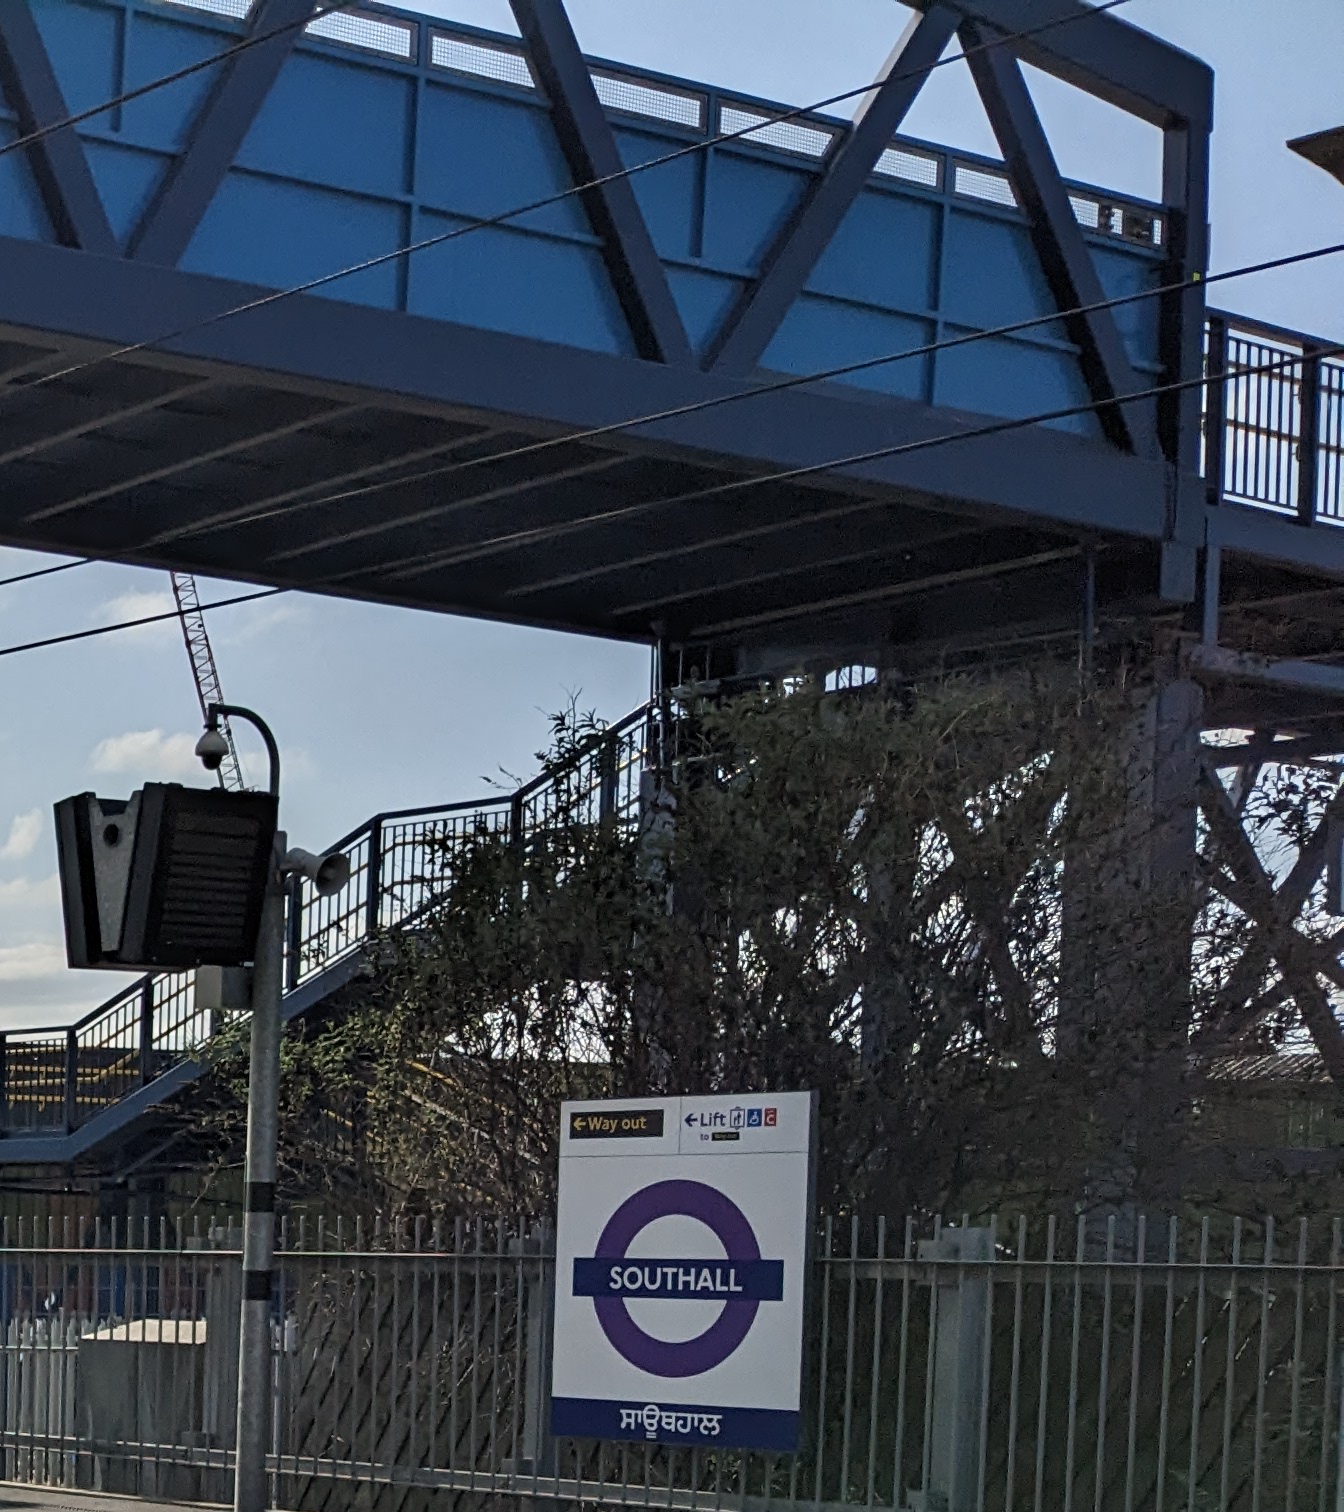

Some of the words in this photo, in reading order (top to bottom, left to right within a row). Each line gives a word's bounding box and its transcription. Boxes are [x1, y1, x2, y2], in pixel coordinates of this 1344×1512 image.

[587, 1116, 618, 1133] Way
[621, 1115, 647, 1130] out
[700, 1112, 726, 1127] Lift
[700, 1133, 710, 1141] to
[609, 1266, 743, 1292] SOUTHALL
[619, 1404, 723, 1439] ਸਾਊਥਹਾਲ
